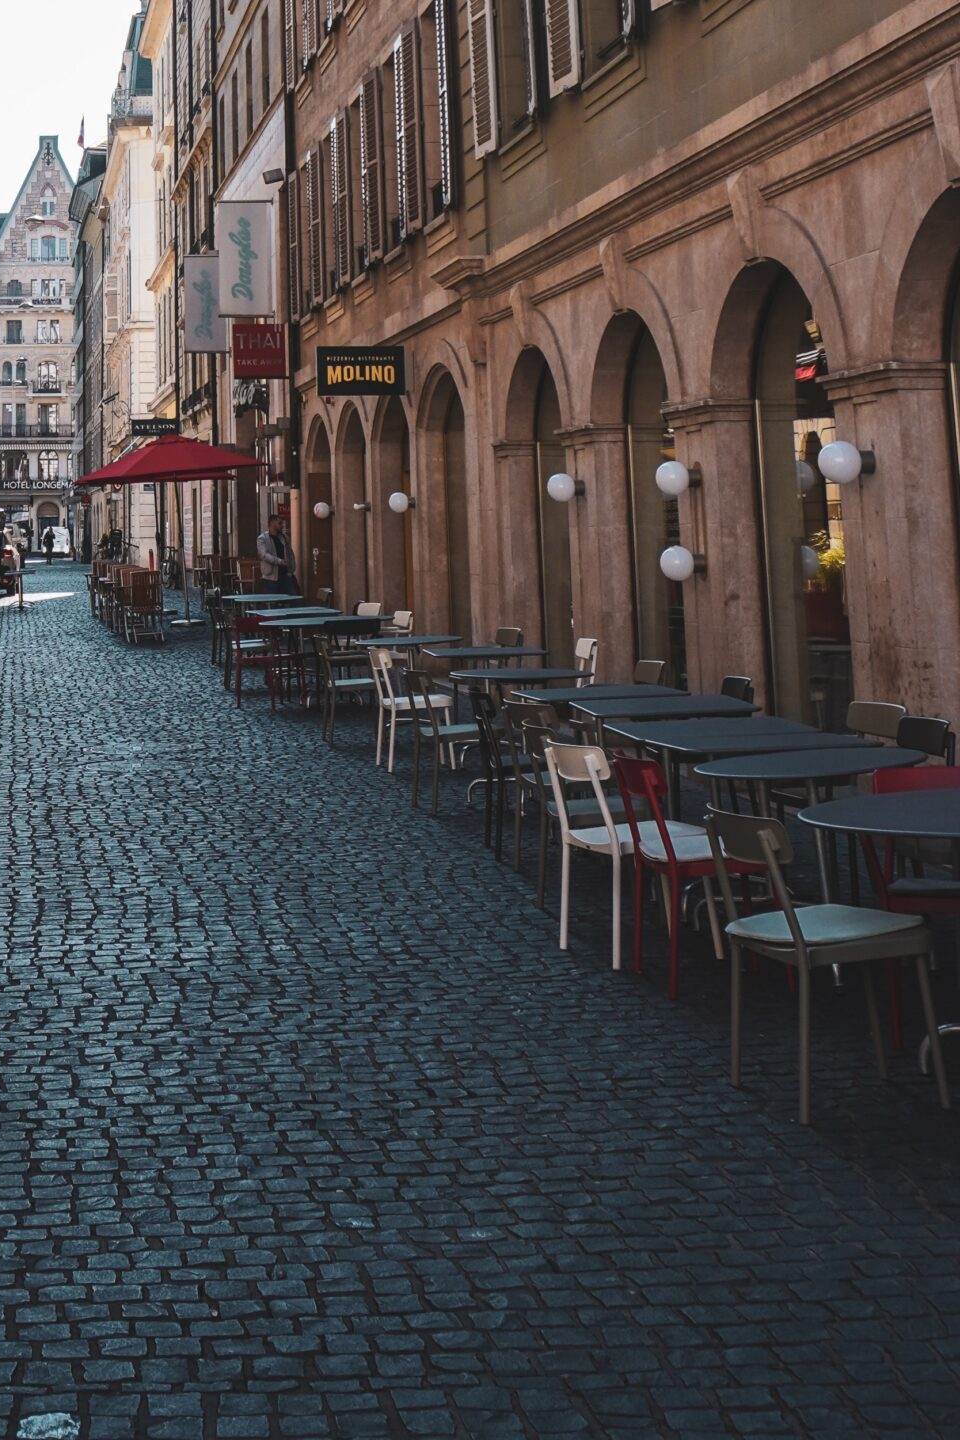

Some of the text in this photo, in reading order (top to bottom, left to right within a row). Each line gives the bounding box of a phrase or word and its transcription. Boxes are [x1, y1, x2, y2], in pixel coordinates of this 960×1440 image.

[228, 216, 258, 302] Douglas
[327, 365, 395, 385] MOLINO
[3, 481, 30, 489] HOTEL
